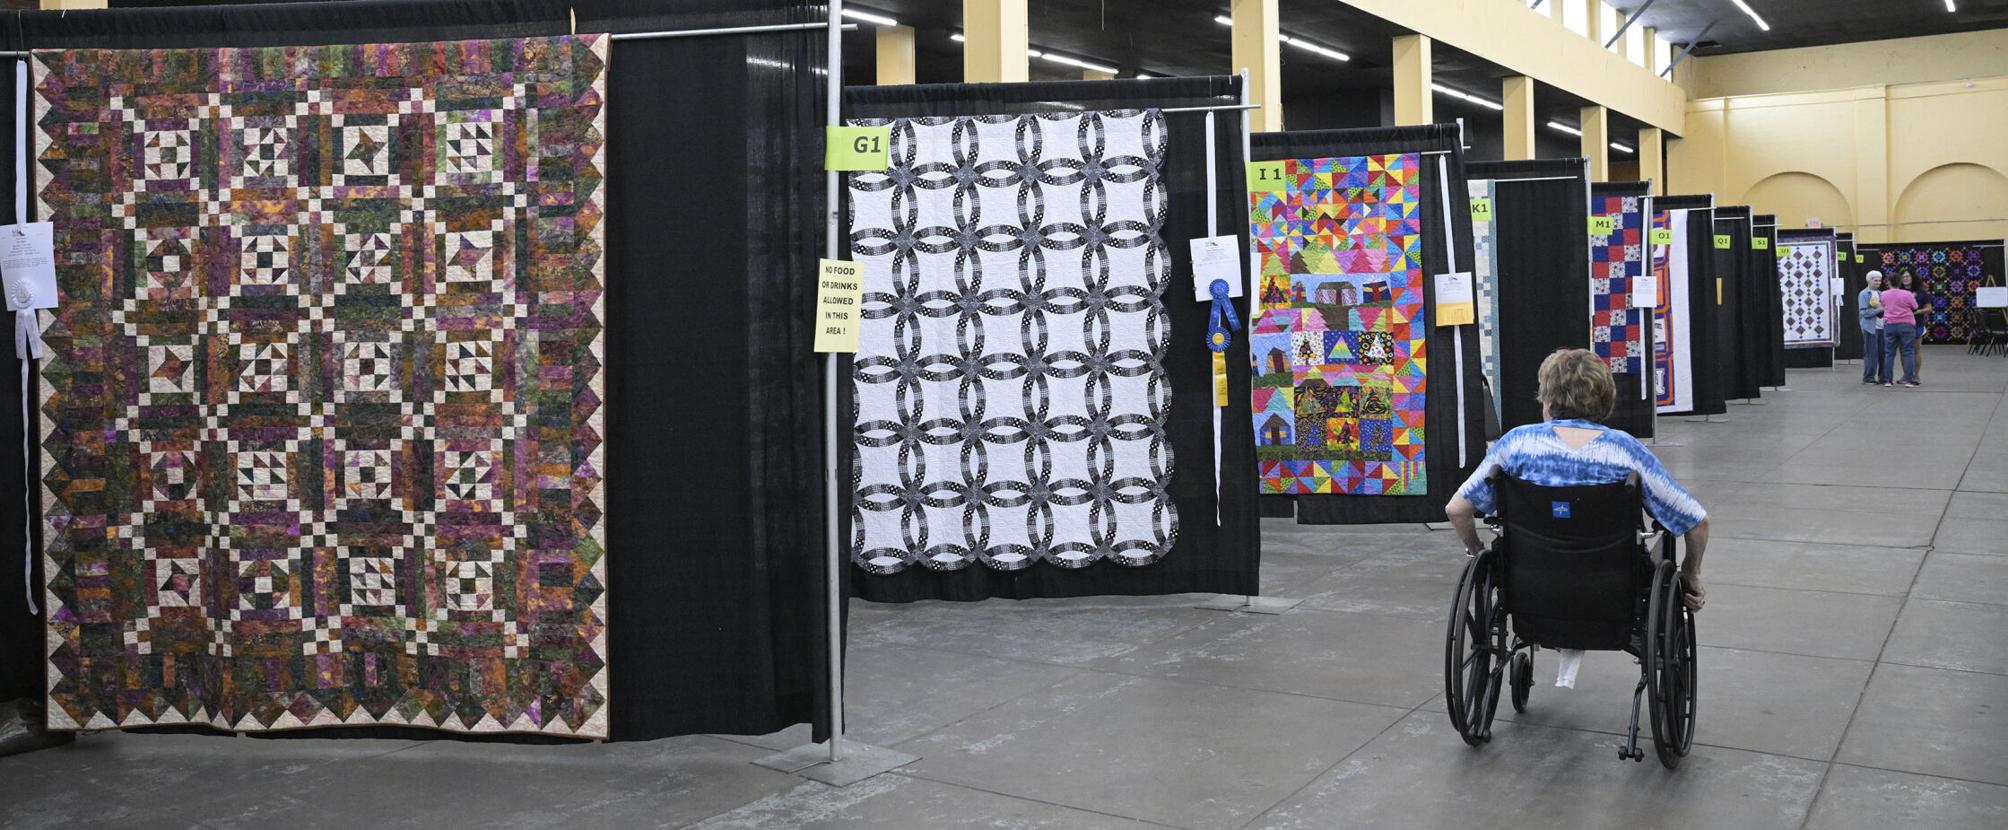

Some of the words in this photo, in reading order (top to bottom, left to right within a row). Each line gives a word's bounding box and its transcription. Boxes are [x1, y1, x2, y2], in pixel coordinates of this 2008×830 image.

[854, 136, 881, 153] G1
[1472, 203, 1488, 213] K1
[825, 266, 833, 274] NO
[833, 266, 855, 276] FOOD
[830, 281, 858, 291] DRINKS
[823, 296, 854, 305] ALLOWED
[825, 311, 831, 319] IN
[832, 312, 848, 320] THIS
[825, 326, 841, 335] AREA
